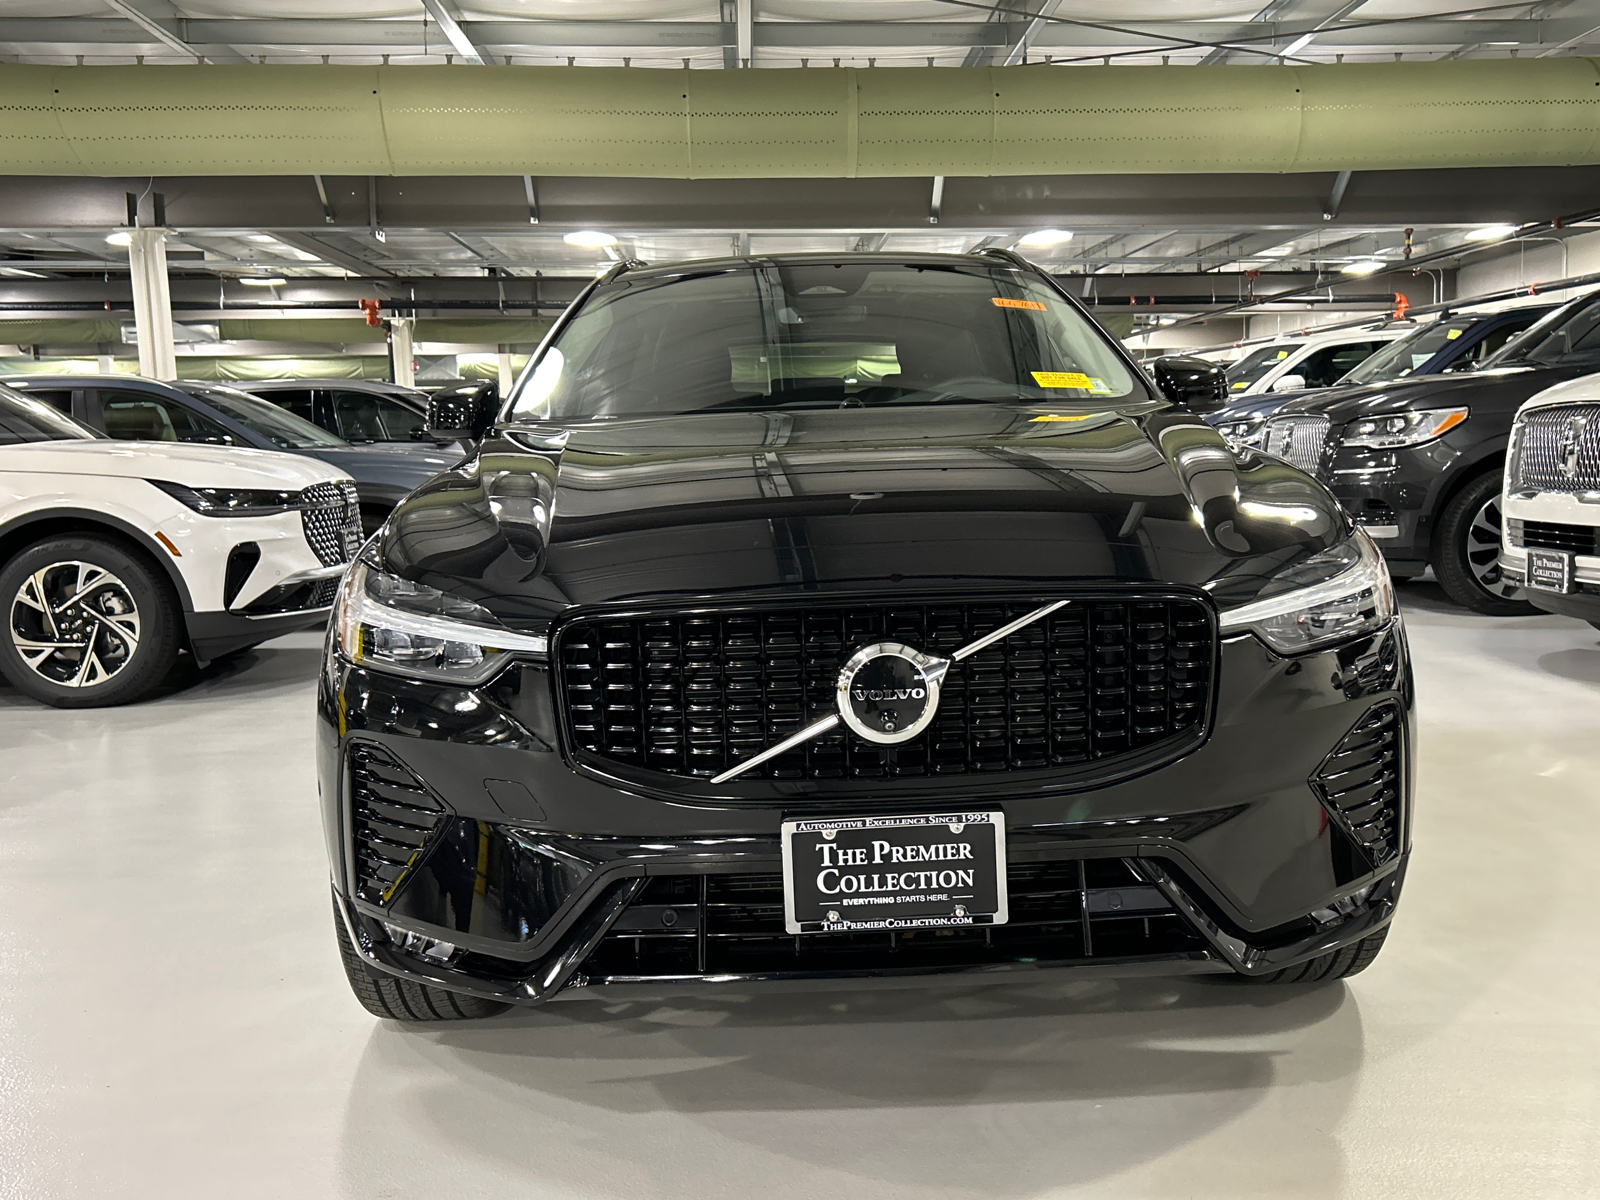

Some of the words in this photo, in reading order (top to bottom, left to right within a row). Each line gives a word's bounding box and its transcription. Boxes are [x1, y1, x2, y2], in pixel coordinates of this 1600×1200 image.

[852, 688, 926, 701] VOLVO
[798, 819, 863, 831] AUTOMOTIVE
[865, 816, 927, 828] EXCELLENCE
[928, 815, 958, 825] SINCE
[961, 813, 988, 823] 1995
[815, 842, 868, 866] THE
[871, 840, 974, 864] PREMIER
[816, 868, 975, 895] COLLECTION
[842, 896, 895, 906] EVERYTHING
[896, 895, 925, 904] STARTS
